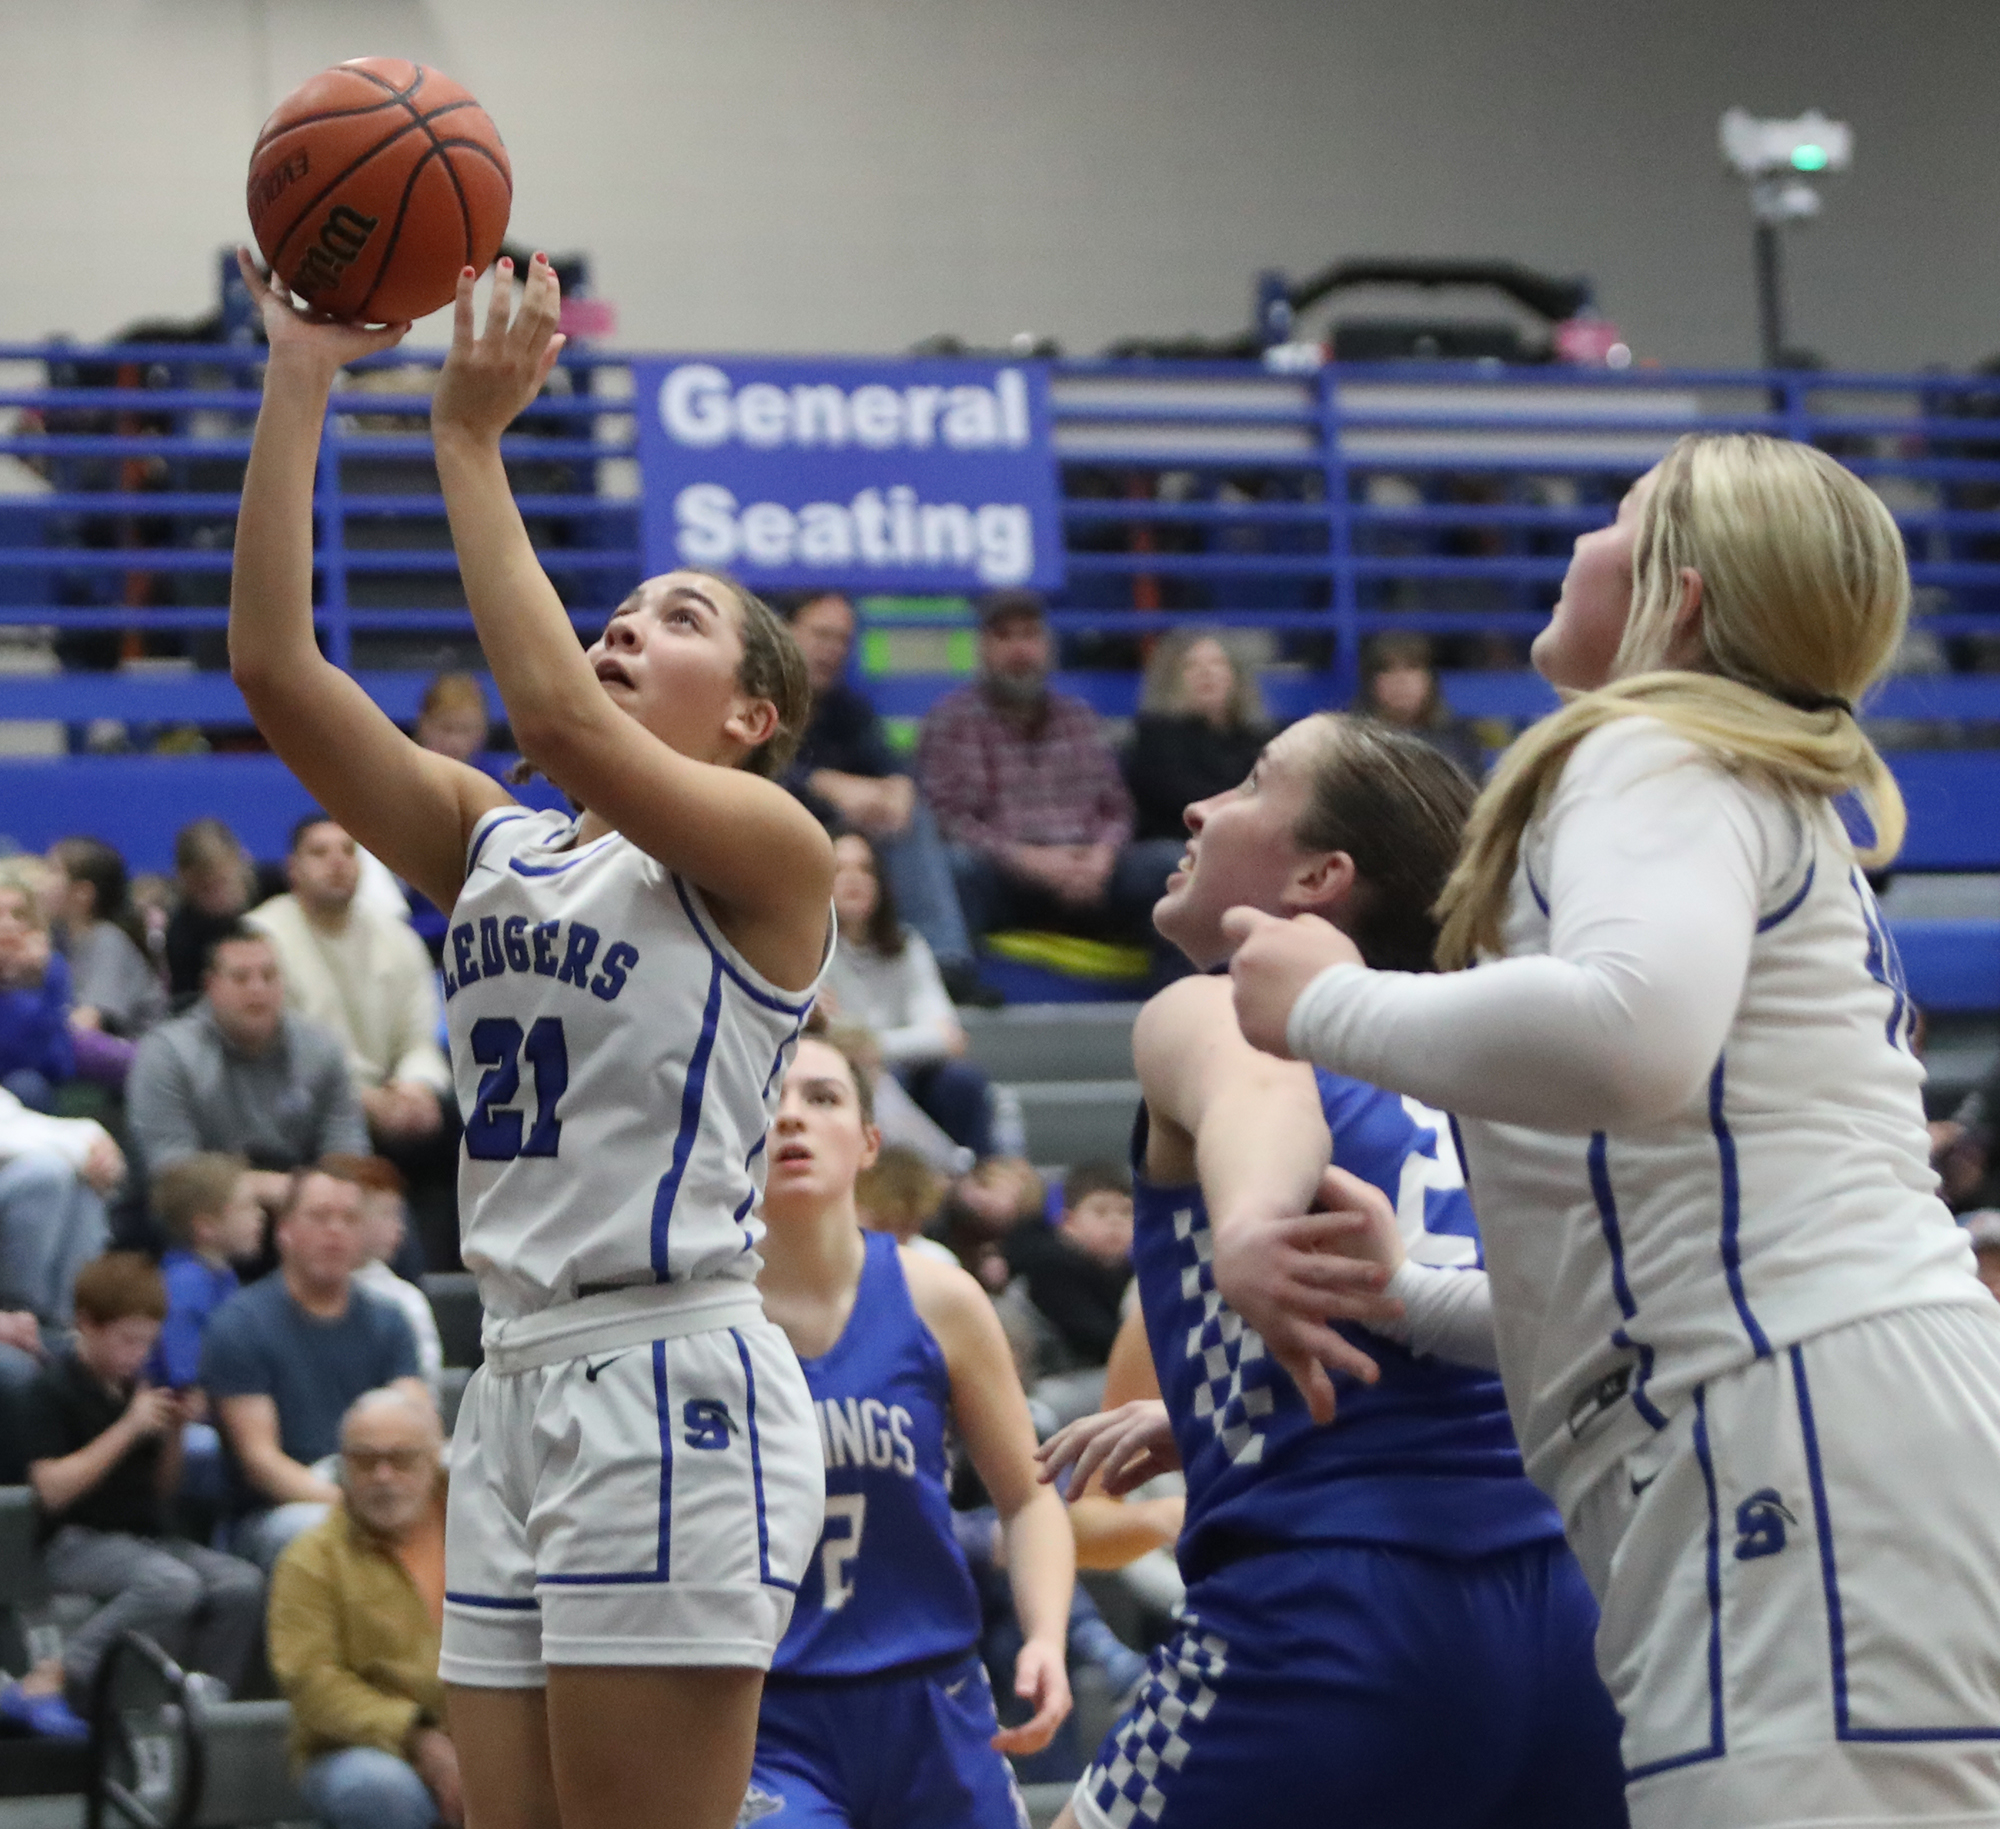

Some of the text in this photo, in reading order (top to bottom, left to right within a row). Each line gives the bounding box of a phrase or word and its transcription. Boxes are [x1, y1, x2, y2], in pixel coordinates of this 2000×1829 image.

[659, 364, 1030, 449] General
[675, 484, 1033, 585] Seating
[465, 1016, 568, 1160] 21
